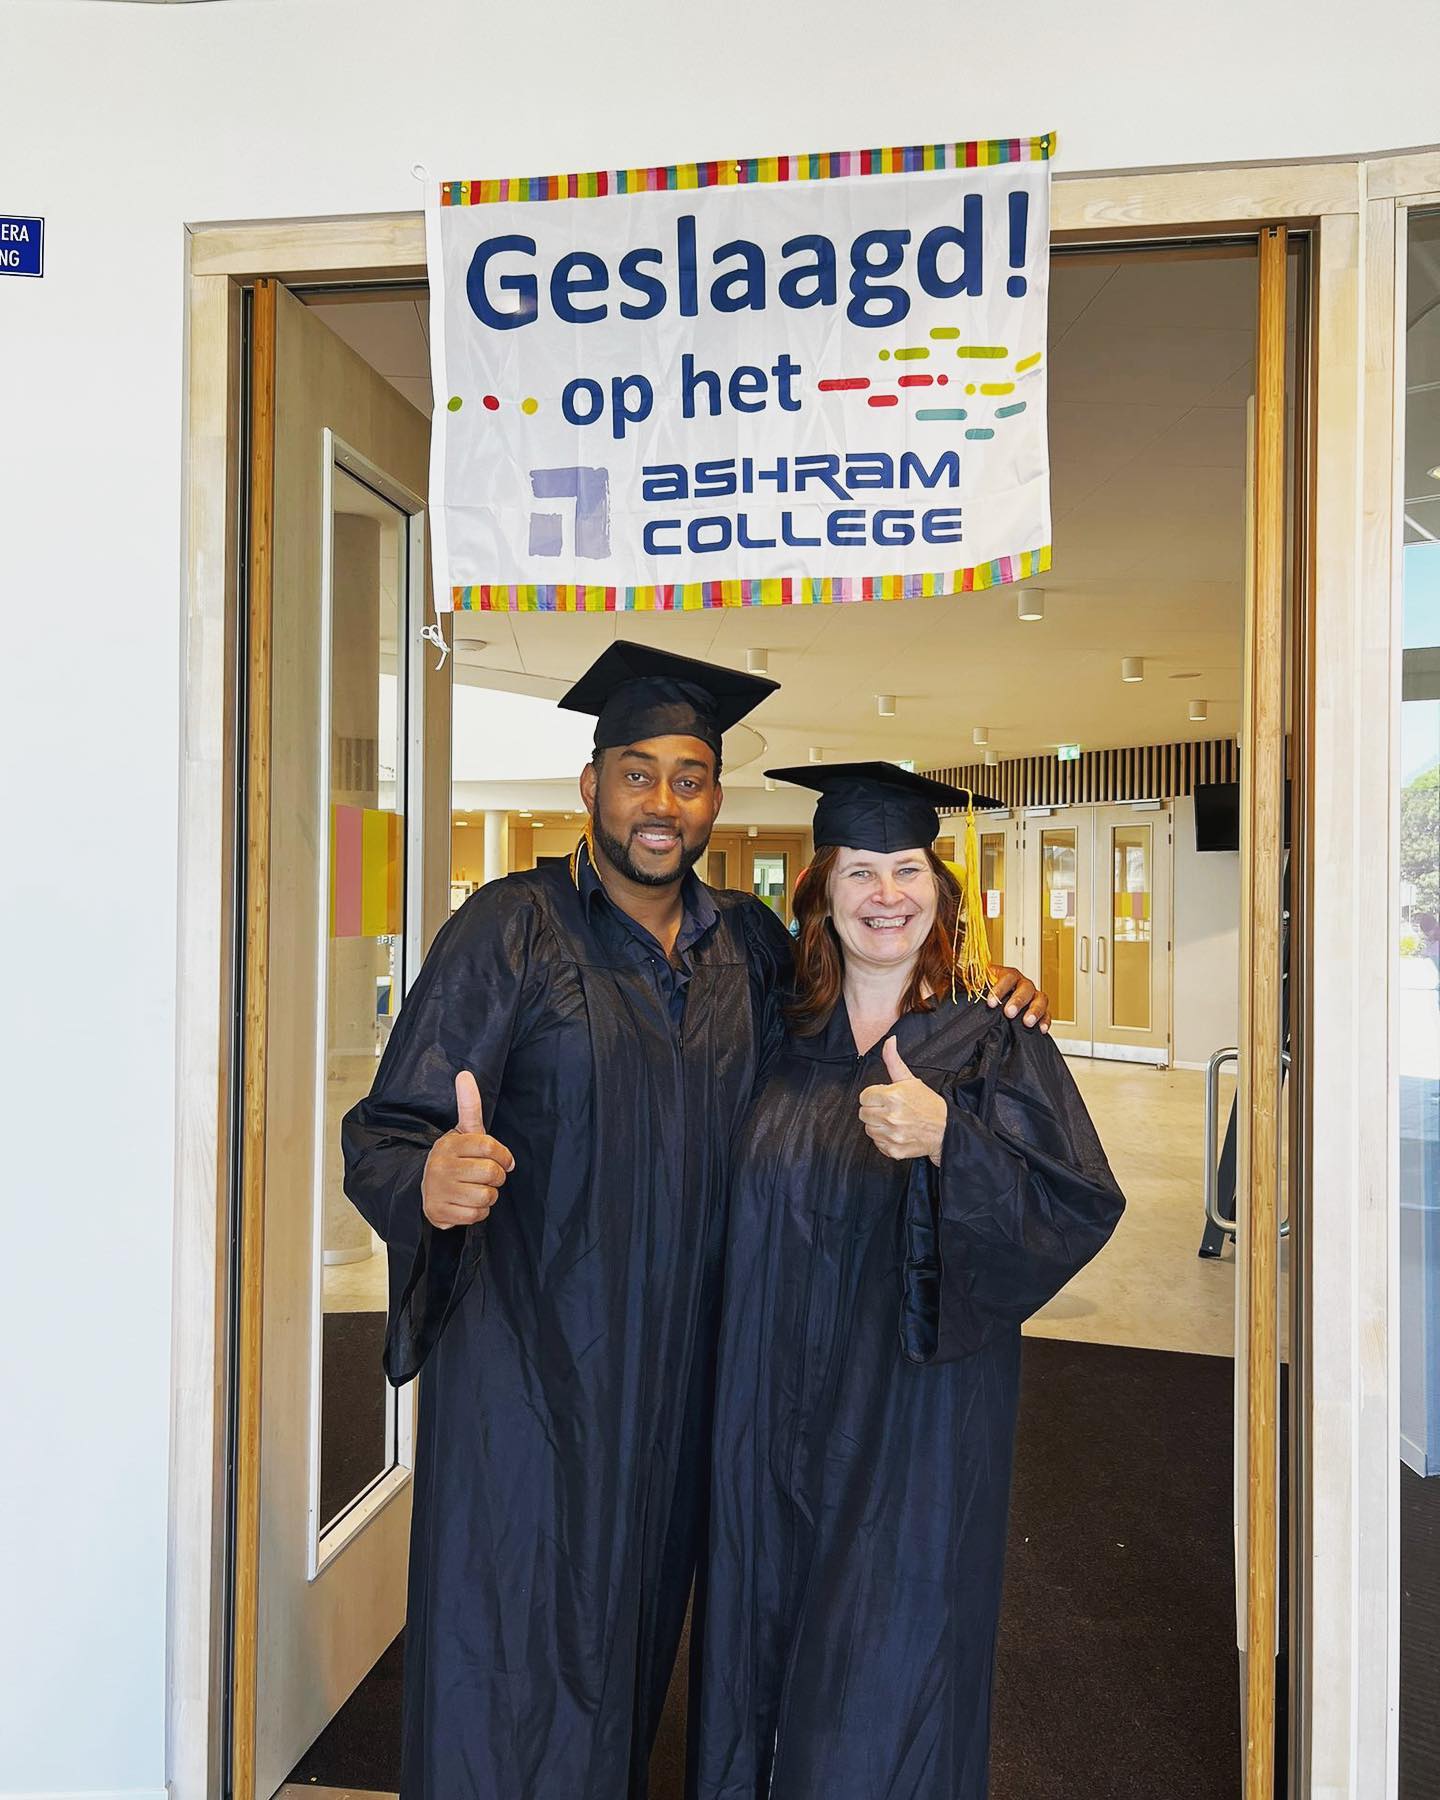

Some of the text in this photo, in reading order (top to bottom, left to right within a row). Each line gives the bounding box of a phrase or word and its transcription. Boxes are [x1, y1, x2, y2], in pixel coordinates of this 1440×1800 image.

[1, 223, 30, 242] ERA
[466, 191, 1029, 331] Geslaagd!
[561, 353, 802, 440] op het
[642, 507, 962, 555] COLLEGE
